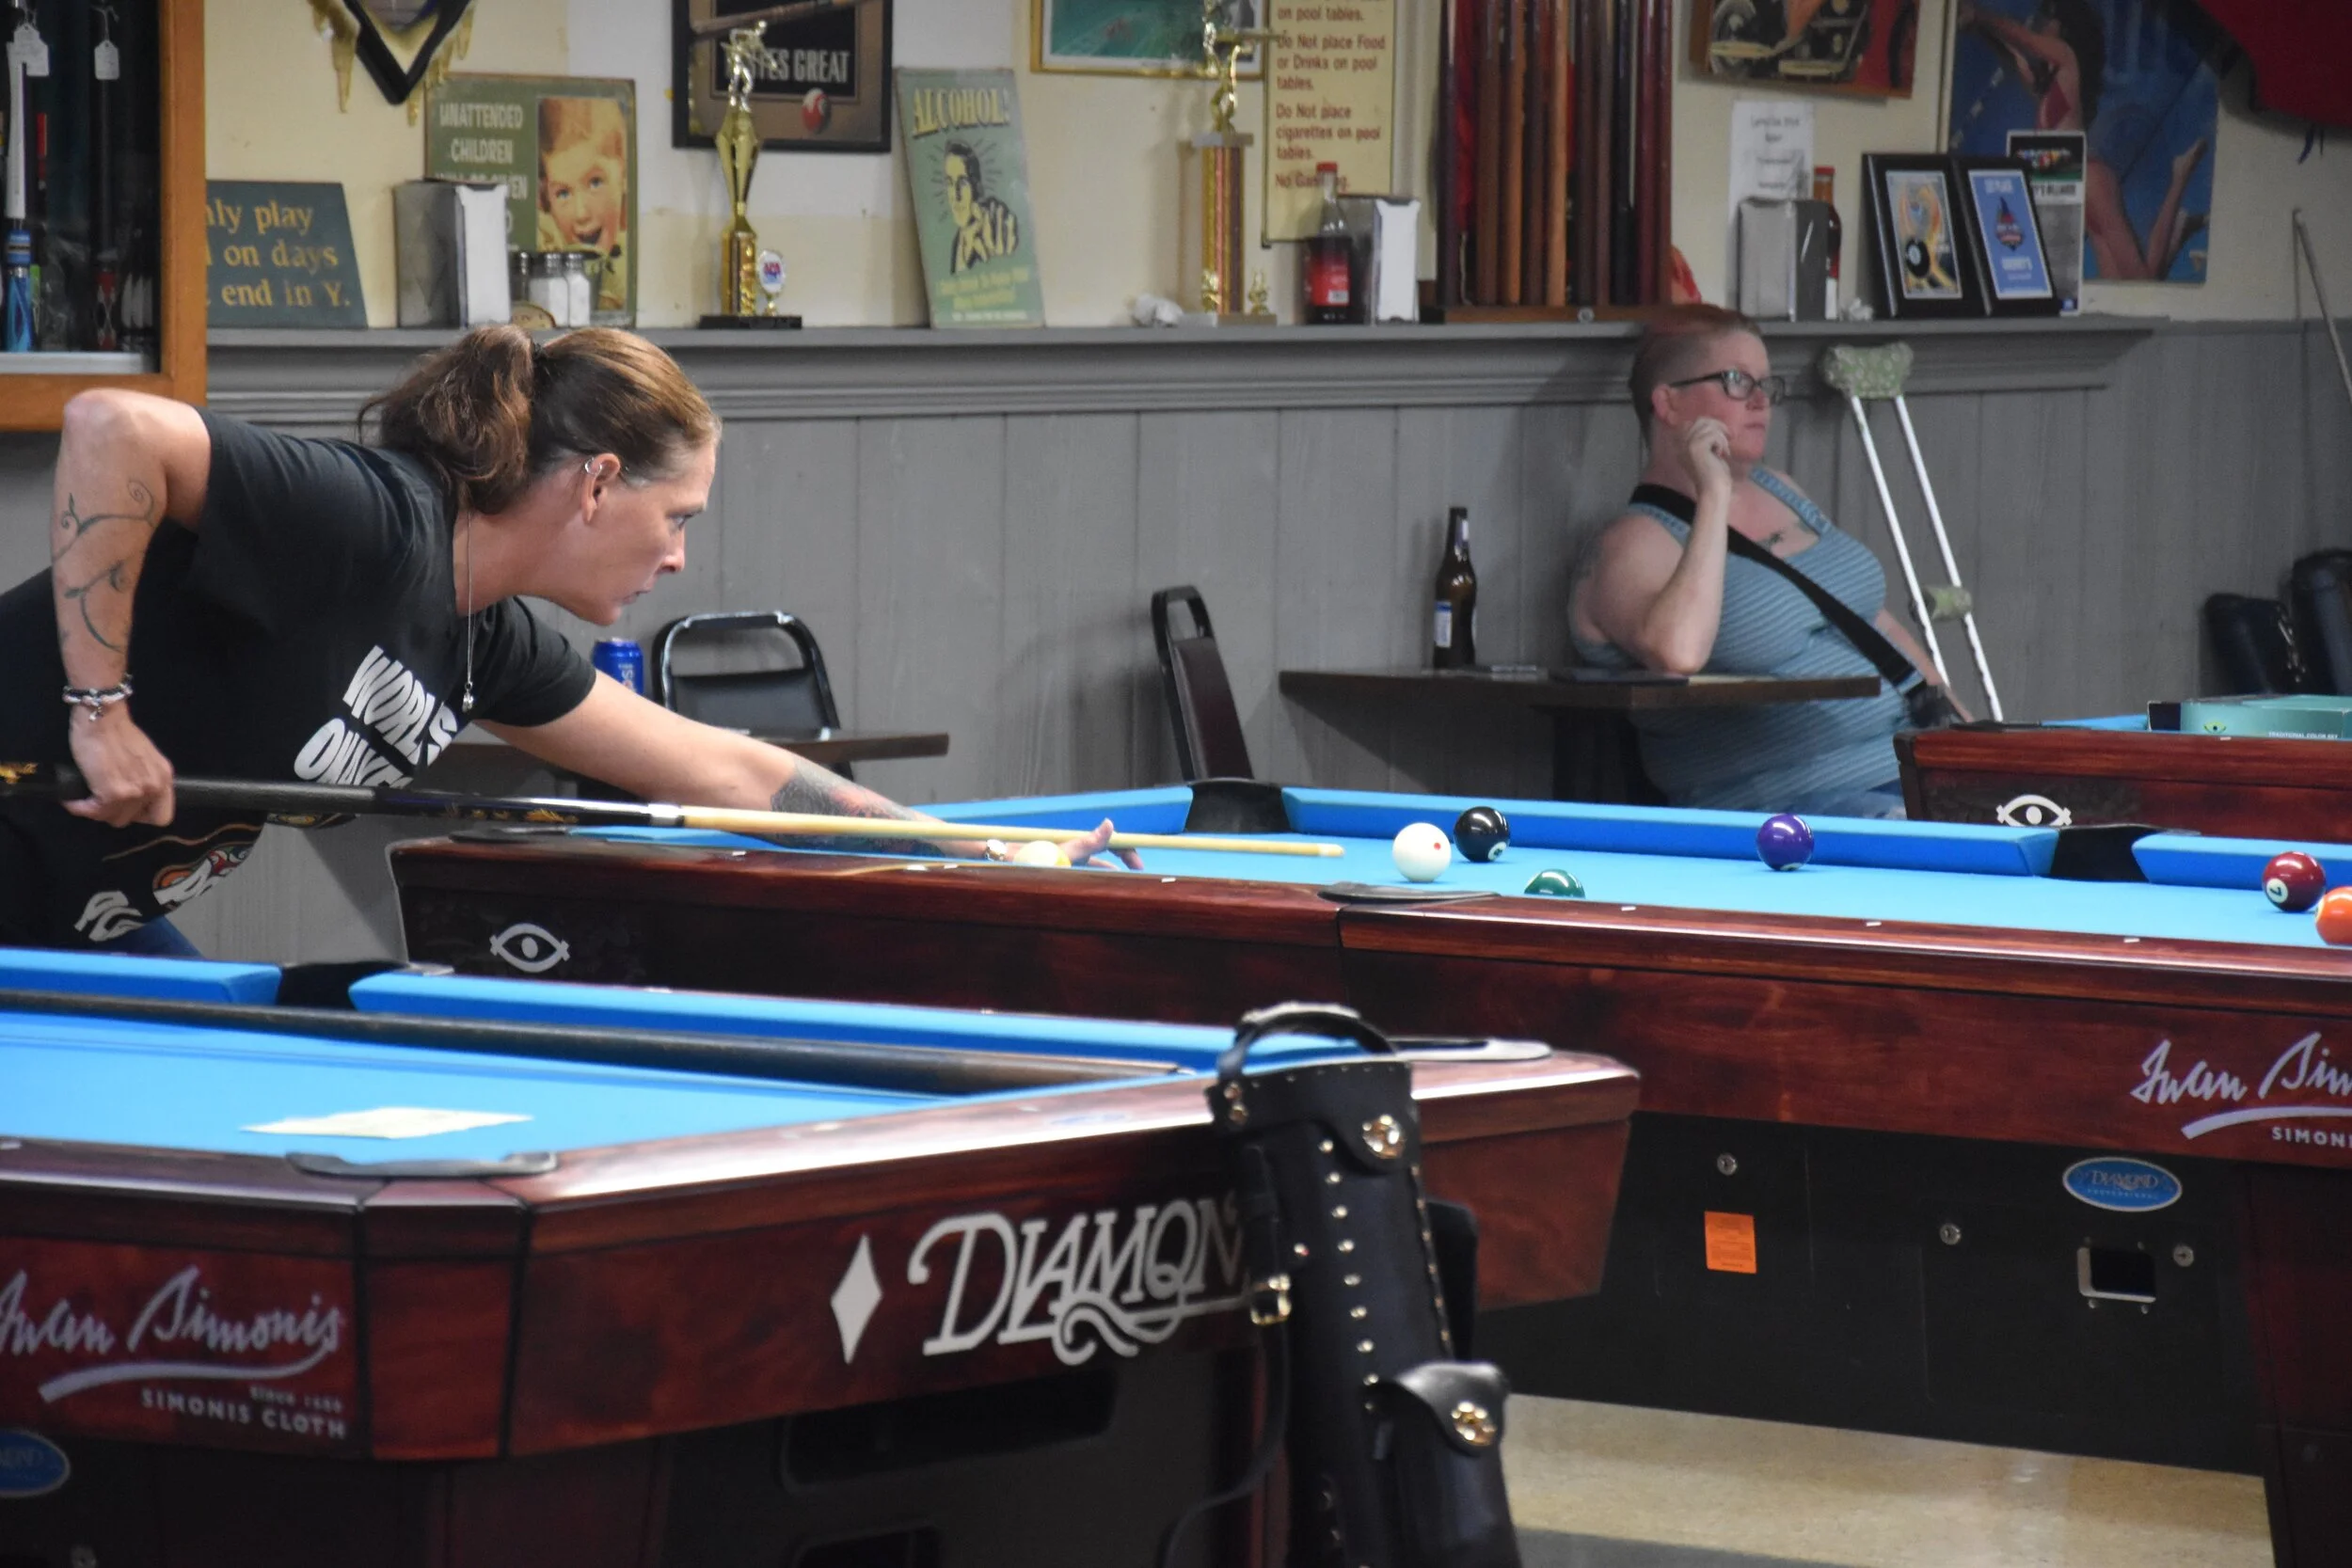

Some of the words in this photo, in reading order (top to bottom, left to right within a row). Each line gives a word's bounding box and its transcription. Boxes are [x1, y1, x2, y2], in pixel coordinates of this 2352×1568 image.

[1296, 33, 1317, 48] Not
[1322, 34, 1352, 51] place
[1358, 33, 1385, 49] Food
[793, 49, 850, 84] GREAT
[1277, 57, 1288, 70] or
[1293, 54, 1328, 71] Drinks
[1333, 57, 1348, 71] on
[1352, 56, 1377, 72] pool
[439, 103, 524, 128] UNATTENDED
[912, 87, 1011, 137] ALCOHOL!
[1276, 103, 1293, 119] Do
[1295, 102, 1317, 119] Not
[1321, 104, 1352, 119] place
[1276, 125, 1332, 141] cigarettes
[1337, 127, 1352, 139] on
[1356, 126, 1381, 142] pool
[451, 137, 513, 165] CHILDREN
[1276, 173, 1292, 187] No
[205, 198, 242, 234] nly
[254, 198, 314, 236] play
[223, 245, 260, 267] on
[271, 238, 339, 276] days
[221, 278, 273, 307] end
[284, 279, 312, 307] in
[321, 280, 351, 308] Y.
[2269, 887, 2282, 896] 7
[907, 1197, 1252, 1365] DIAMON
[126, 1265, 341, 1353] Simonis
[142, 1387, 251, 1425] SIMONIS
[262, 1408, 346, 1440] CLOTH
